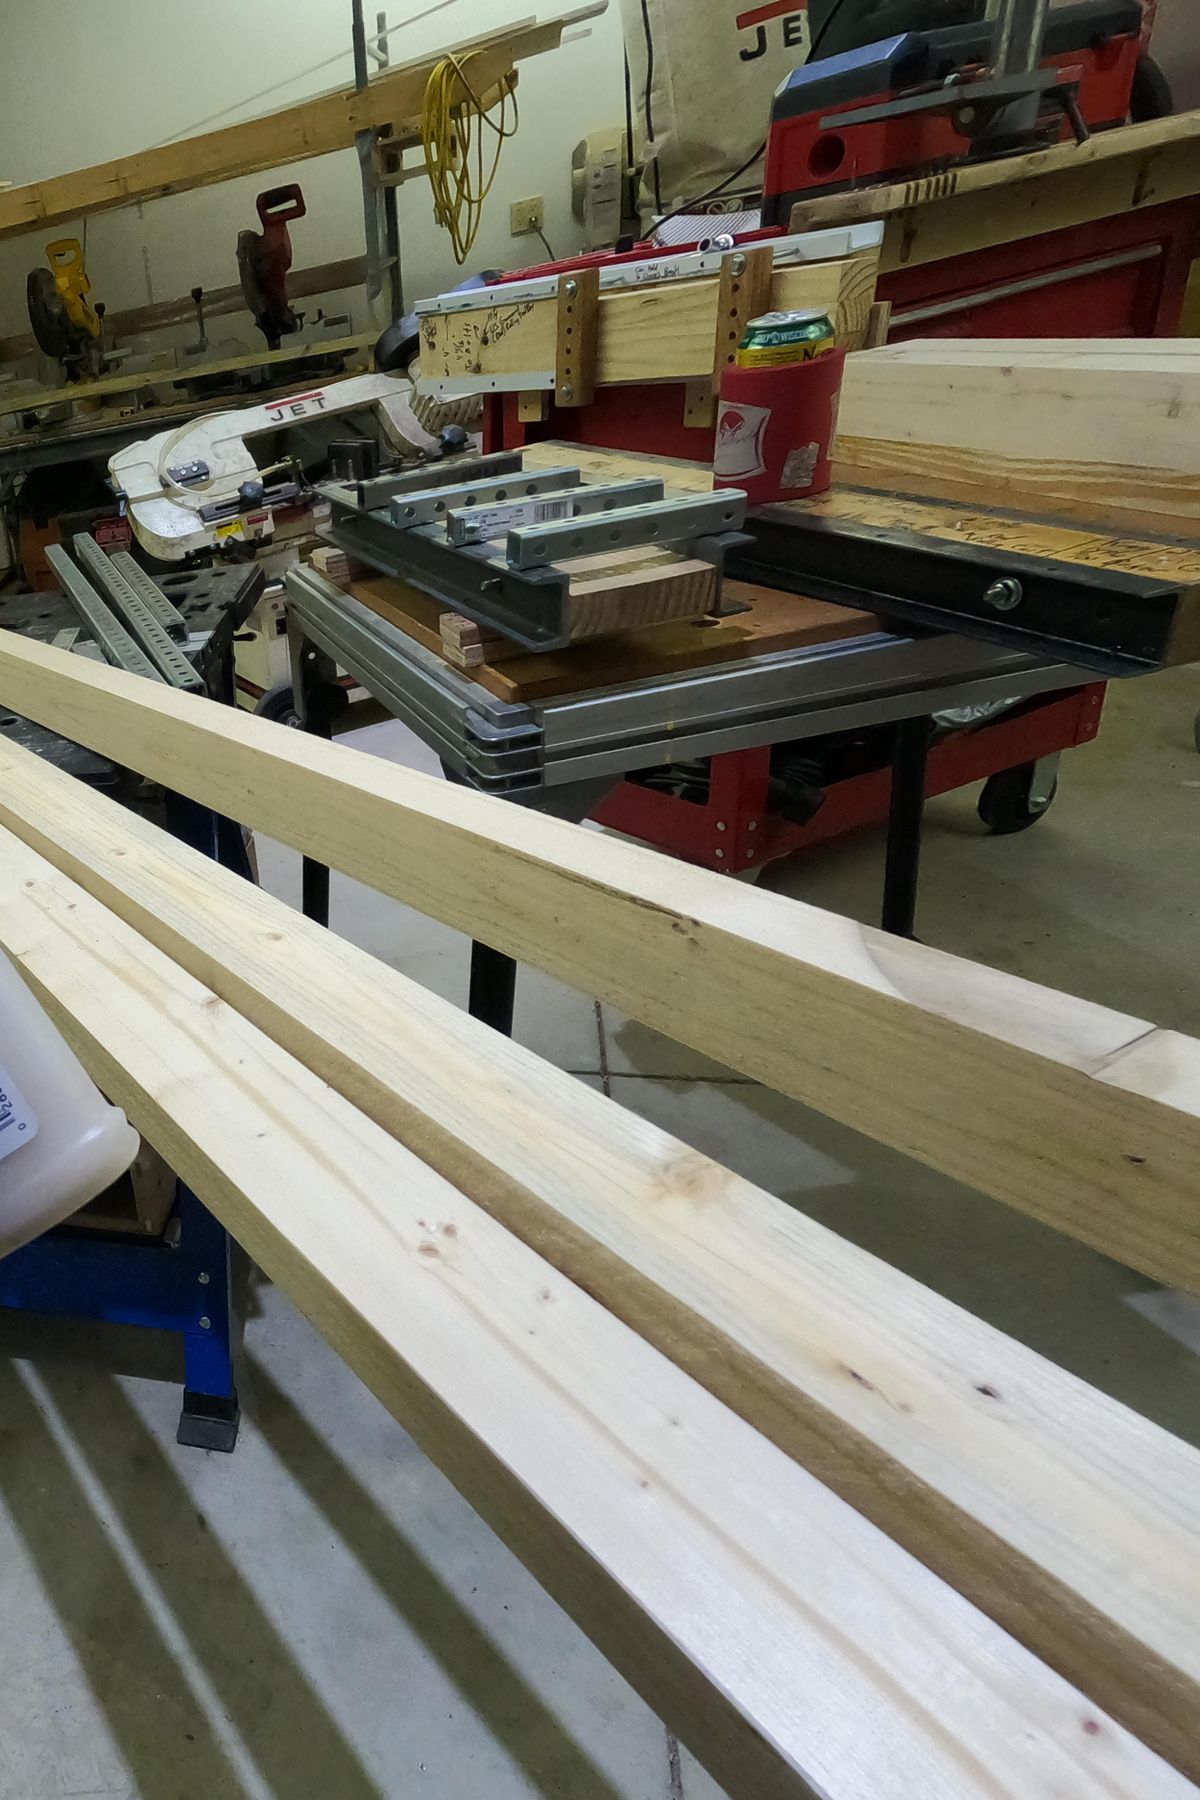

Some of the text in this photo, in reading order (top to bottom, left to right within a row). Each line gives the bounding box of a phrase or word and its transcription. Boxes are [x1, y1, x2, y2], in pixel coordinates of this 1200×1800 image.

[739, 13, 803, 62] JE
[270, 397, 326, 422] JET
[17, 1122, 27, 1132] 0
